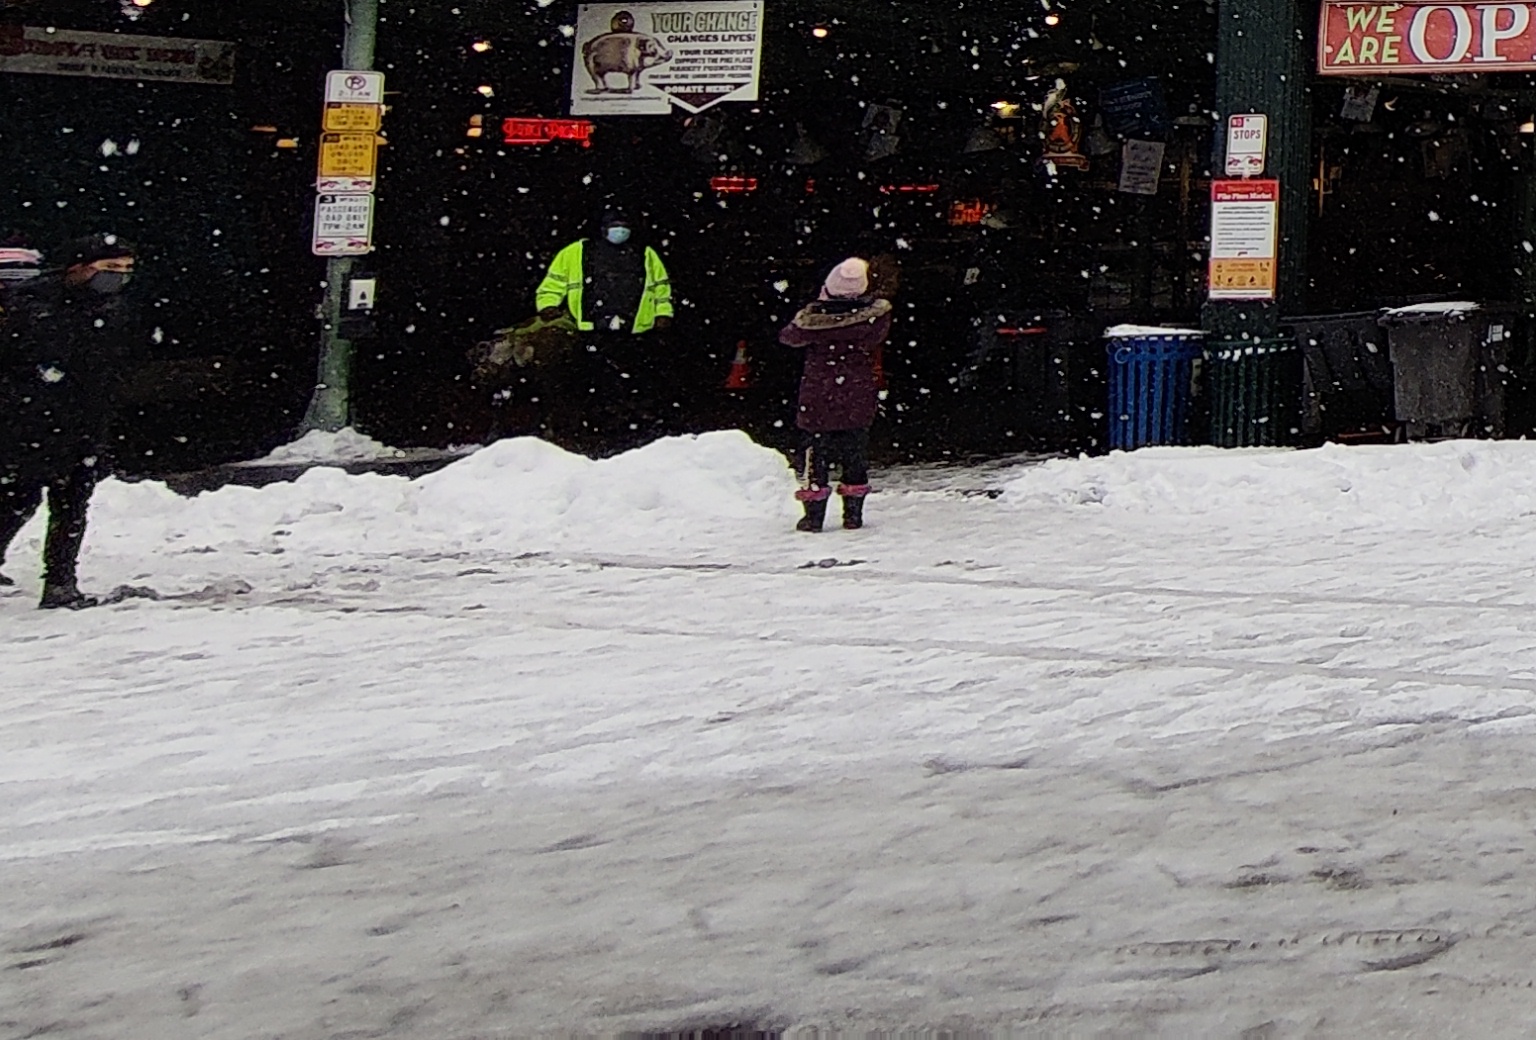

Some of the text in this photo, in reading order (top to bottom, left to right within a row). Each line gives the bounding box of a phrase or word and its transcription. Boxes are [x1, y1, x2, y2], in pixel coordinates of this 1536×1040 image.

[651, 11, 758, 34] YOUR CHANGE
[1346, 6, 1396, 33] WE
[667, 34, 719, 44] CHANGES
[679, 48, 702, 56] YOUR
[1333, 35, 1401, 64] ARE
[664, 85, 704, 94] DONATE
[1233, 129, 1261, 140] STOPS
